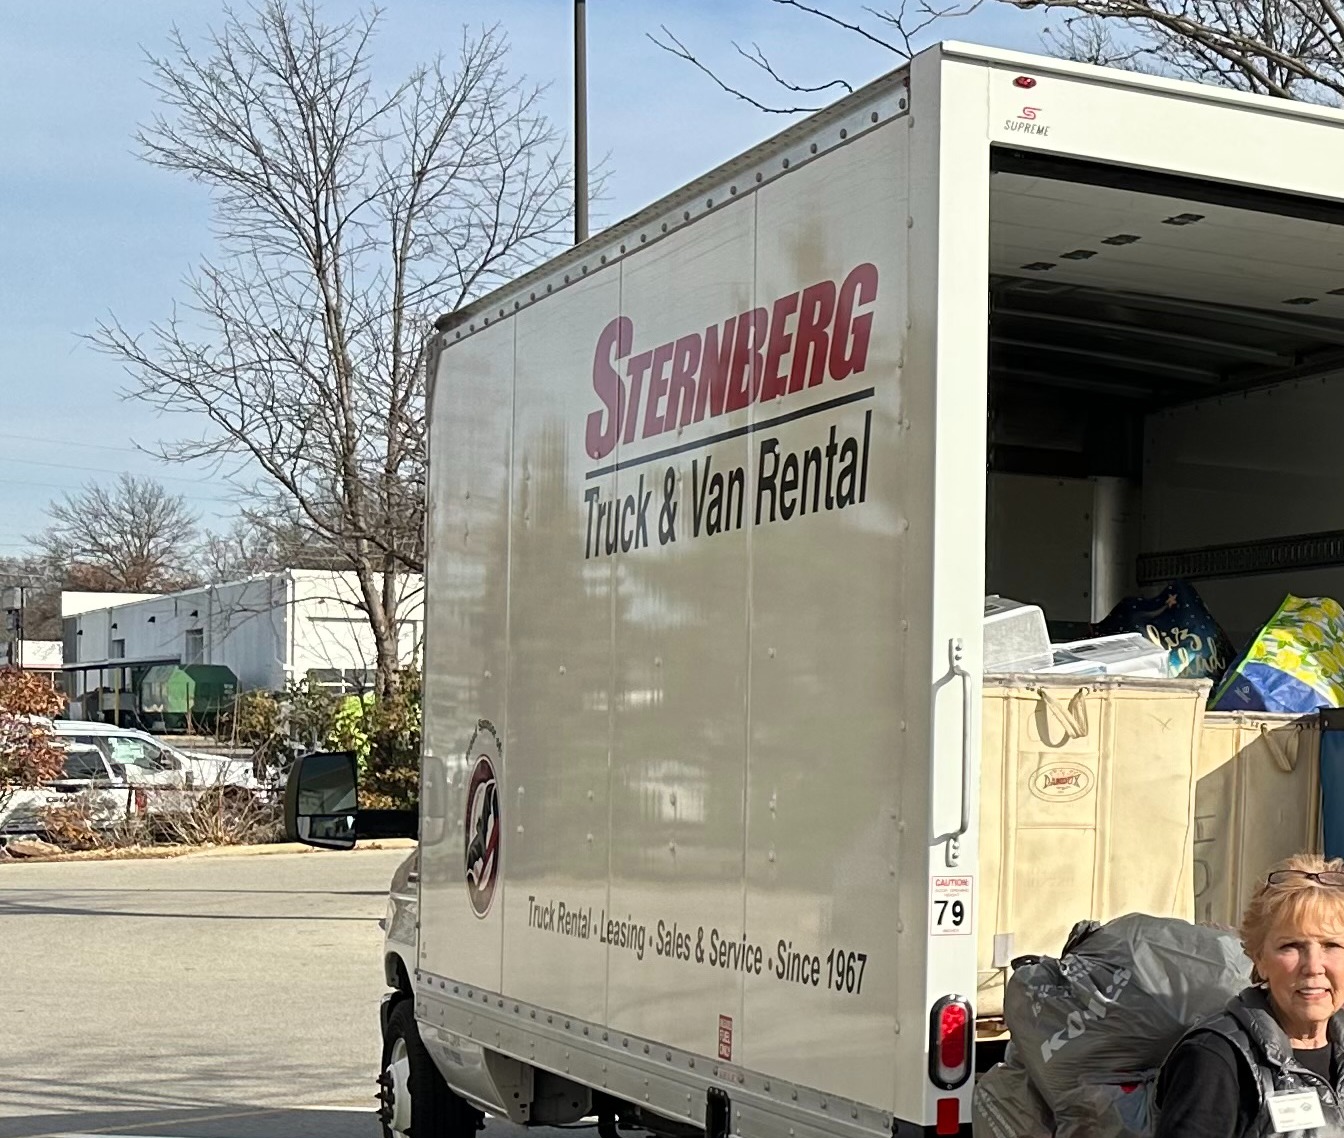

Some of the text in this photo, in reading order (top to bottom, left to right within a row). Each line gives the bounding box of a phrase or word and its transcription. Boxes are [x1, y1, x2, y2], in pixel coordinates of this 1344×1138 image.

[1003, 119, 1051, 137] SUPREME
[585, 262, 879, 460] STERNBERG
[585, 409, 872, 559] Truck & Van Rental
[934, 900, 965, 927] 79
[935, 879, 969, 887] CAUTION
[528, 895, 867, 995] Truck Rental Leasing Sales & Service Since 1967
